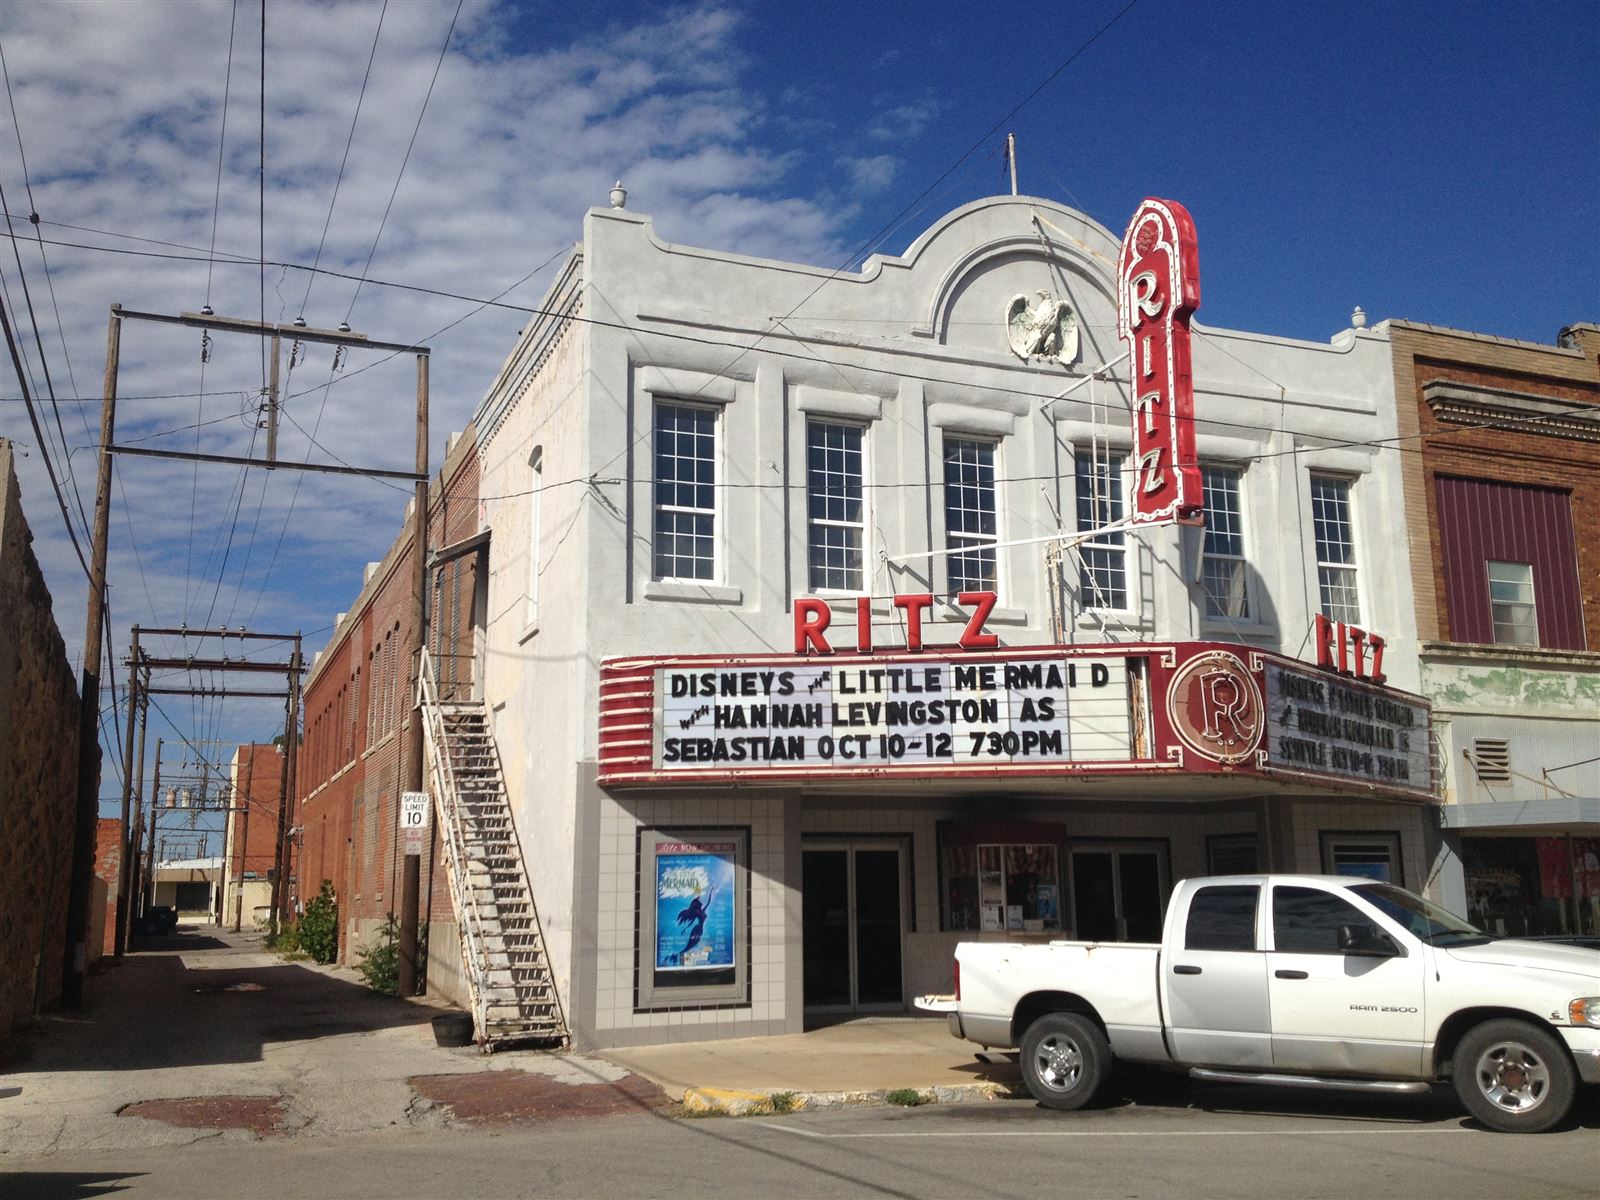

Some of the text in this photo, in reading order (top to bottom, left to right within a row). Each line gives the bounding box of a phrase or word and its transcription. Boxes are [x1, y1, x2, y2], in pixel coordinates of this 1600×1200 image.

[1129, 270, 1164, 493] RITZ
[793, 591, 1000, 655] RITZ
[1315, 613, 1387, 684] RITZ
[671, 663, 1109, 698] DISNEYS THE LITTLE MERMAID
[679, 697, 1056, 730] WITH HANNAH LEVINGSTON AS
[663, 735, 805, 762] SEBASTIAN
[817, 734, 871, 760] OCT
[880, 732, 952, 759] 10-12
[404, 795, 427, 803] SPEED
[405, 803, 424, 811] LIMIT
[407, 811, 422, 825] 10
